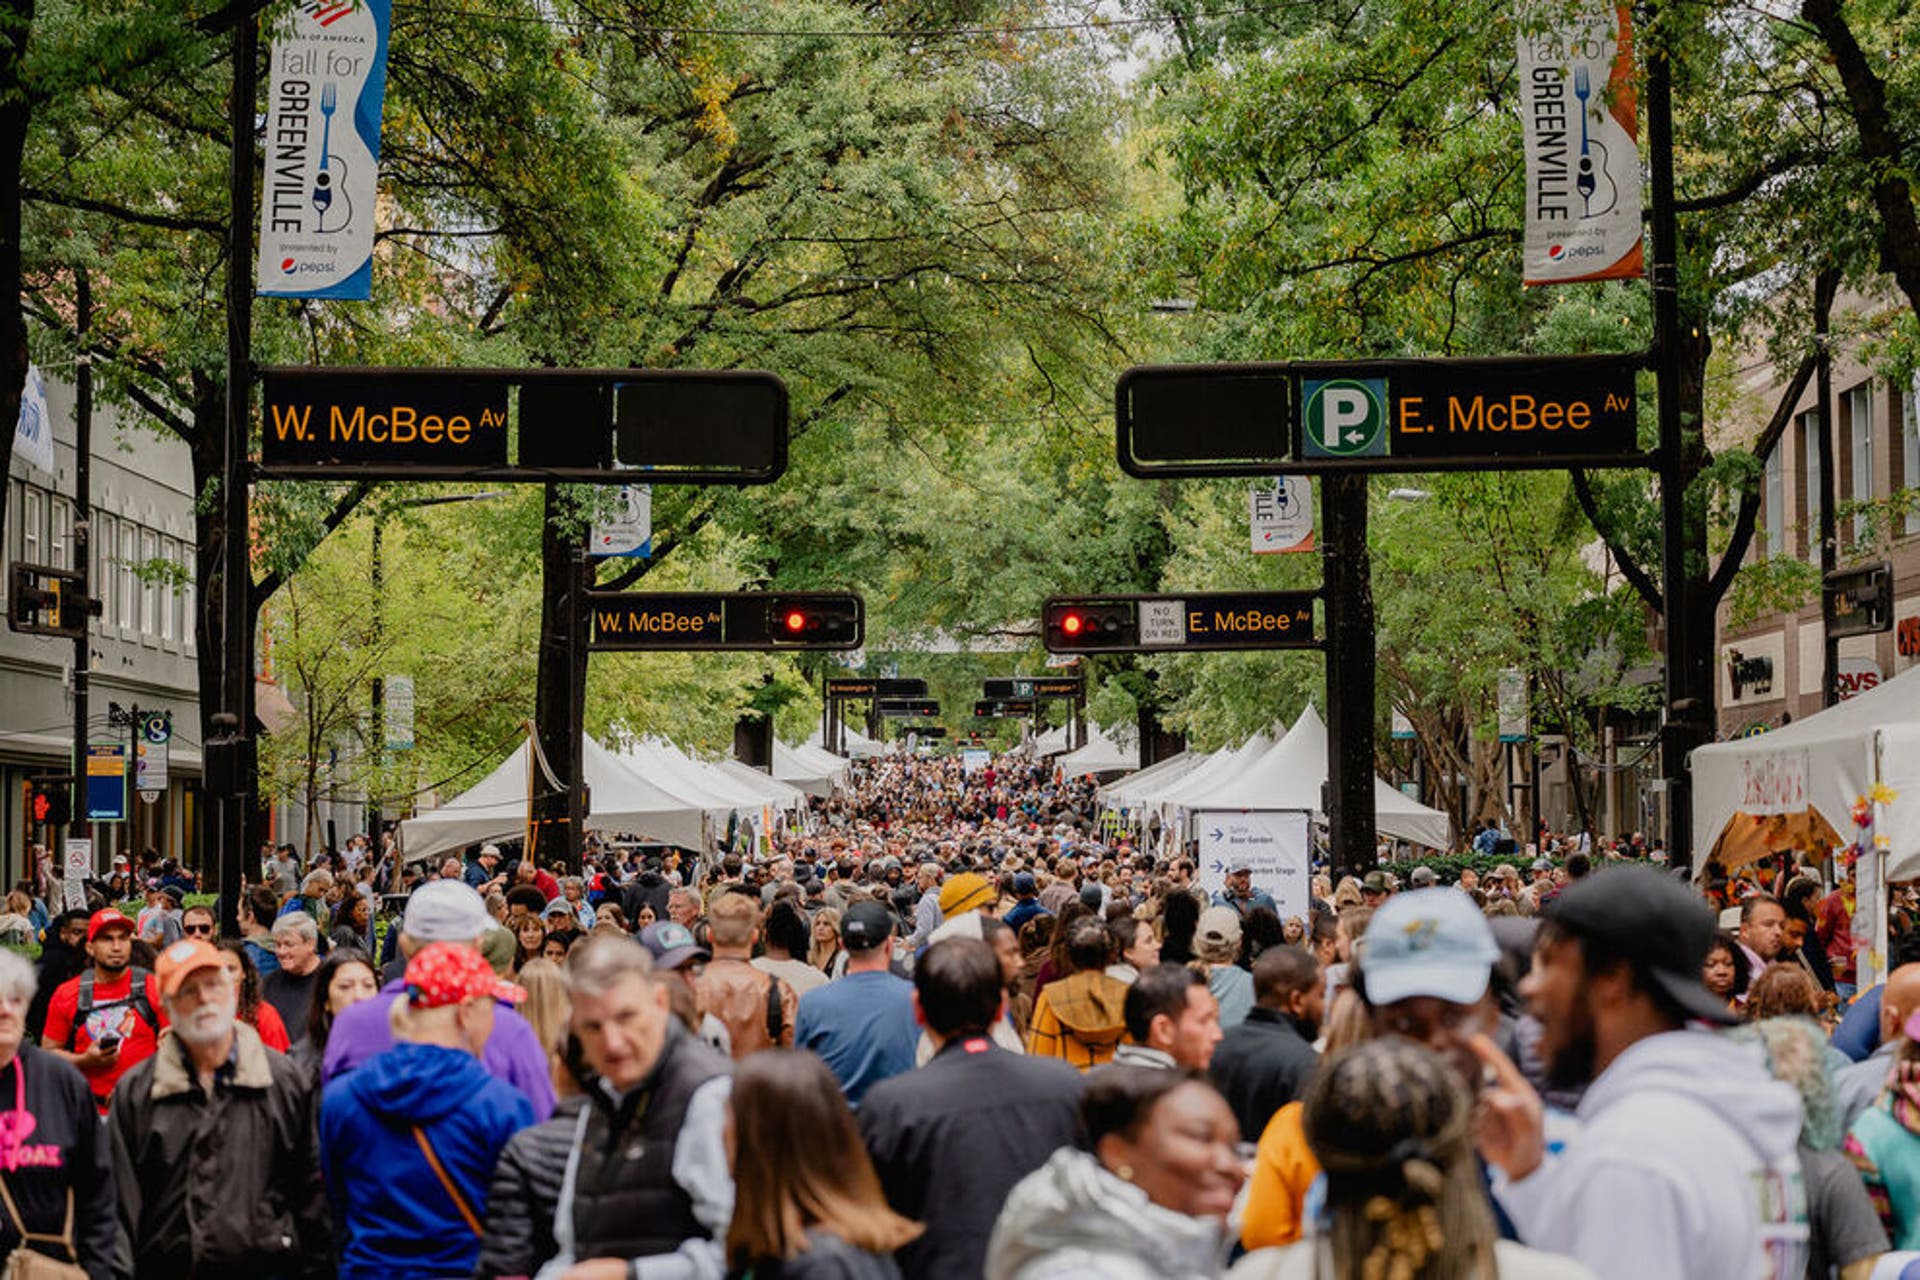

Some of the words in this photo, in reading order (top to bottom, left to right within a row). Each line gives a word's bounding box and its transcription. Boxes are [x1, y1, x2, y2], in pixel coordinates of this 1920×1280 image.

[323, 35, 365, 43] AMERICA
[281, 48, 317, 75] fall
[327, 49, 363, 76] for
[1532, 66, 1568, 221] GREENVILLE
[271, 80, 310, 233] GREENVILLE
[1568, 243, 1604, 258] pepsi
[300, 260, 335, 274] pepsi
[1323, 388, 1369, 447] P
[1400, 397, 1434, 433] E.
[1449, 395, 1592, 432] McBee
[1604, 393, 1630, 413] Av
[272, 405, 316, 441] W.
[330, 406, 471, 444] McBee
[479, 408, 505, 428] Av
[1153, 606, 1170, 616] NO
[599, 613, 622, 632] W.
[629, 613, 704, 632] McBee
[707, 612, 721, 622] Av
[1151, 618, 1175, 627] TURN
[1189, 612, 1209, 632] E.
[1215, 610, 1290, 632] McBee
[1296, 610, 1310, 621] Av
[1144, 629, 1159, 639] ON
[1161, 630, 1180, 639] RED
[1248, 835, 1273, 844] Garden
[1275, 866, 1296, 877] Stage
